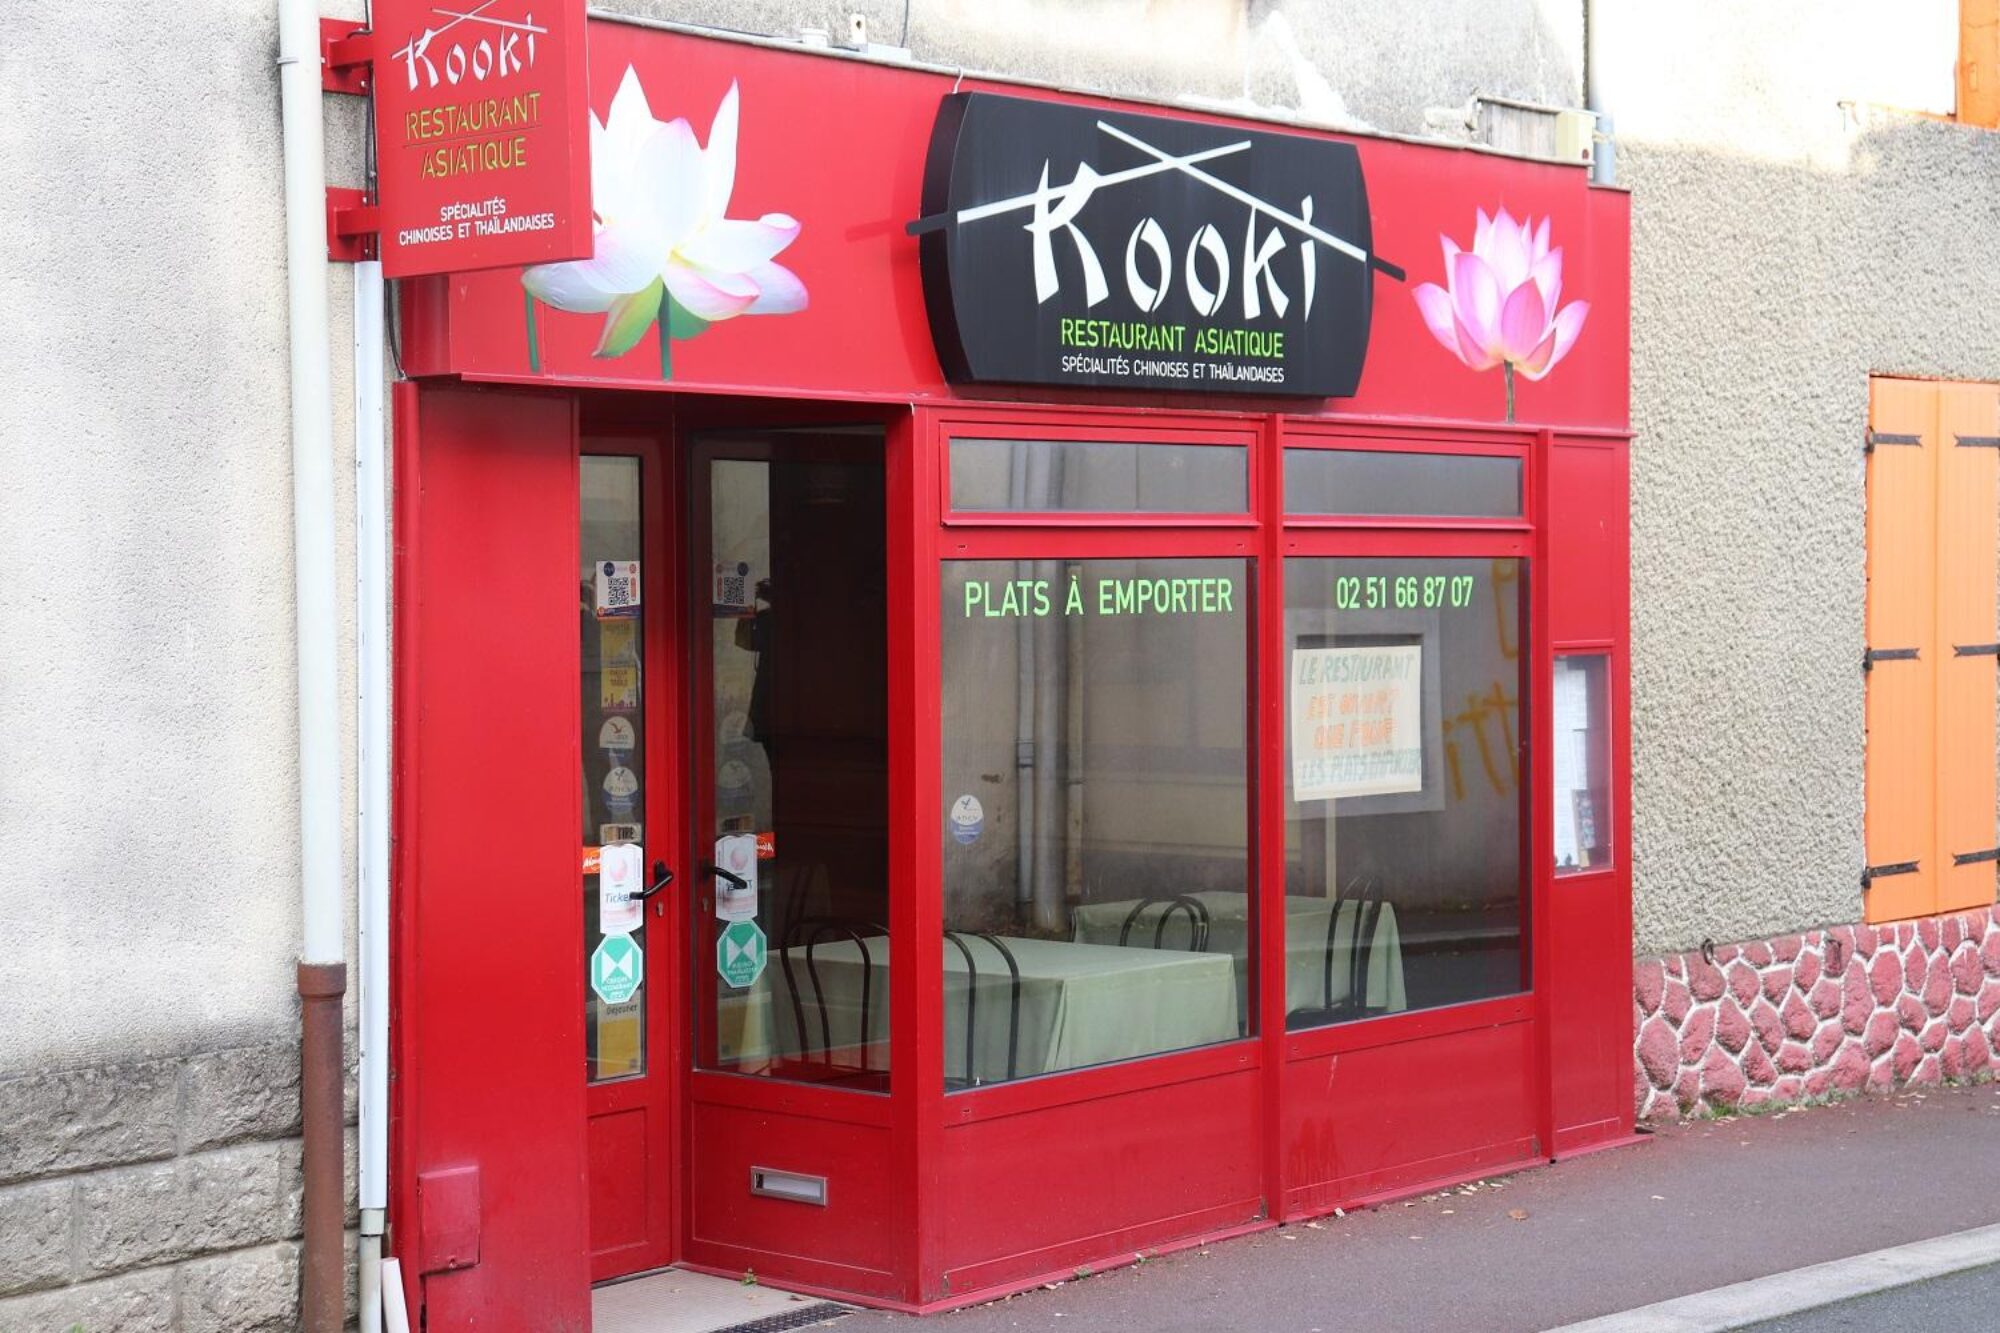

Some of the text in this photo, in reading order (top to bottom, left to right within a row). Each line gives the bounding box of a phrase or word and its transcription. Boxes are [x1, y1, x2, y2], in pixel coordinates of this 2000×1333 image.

[406, 93, 541, 140] RESTAURANT
[421, 138, 527, 180] ASIATIQUE
[440, 196, 507, 222] SPÉCIALITÉS
[399, 213, 555, 246] CHINOISES ET THAÏLANDAISES
[1061, 318, 1285, 359] RESTAURANT ASIATIQUE
[1061, 355, 1285, 384] SPÉCIALITÉS CHINOISES ET THAÏLANDAISES
[964, 575, 1234, 618] PLATS À EMPORTER
[1336, 575, 1474, 609] 02 51 66 87 07
[1299, 656, 1318, 685] LE
[605, 892, 631, 904] Ticke
